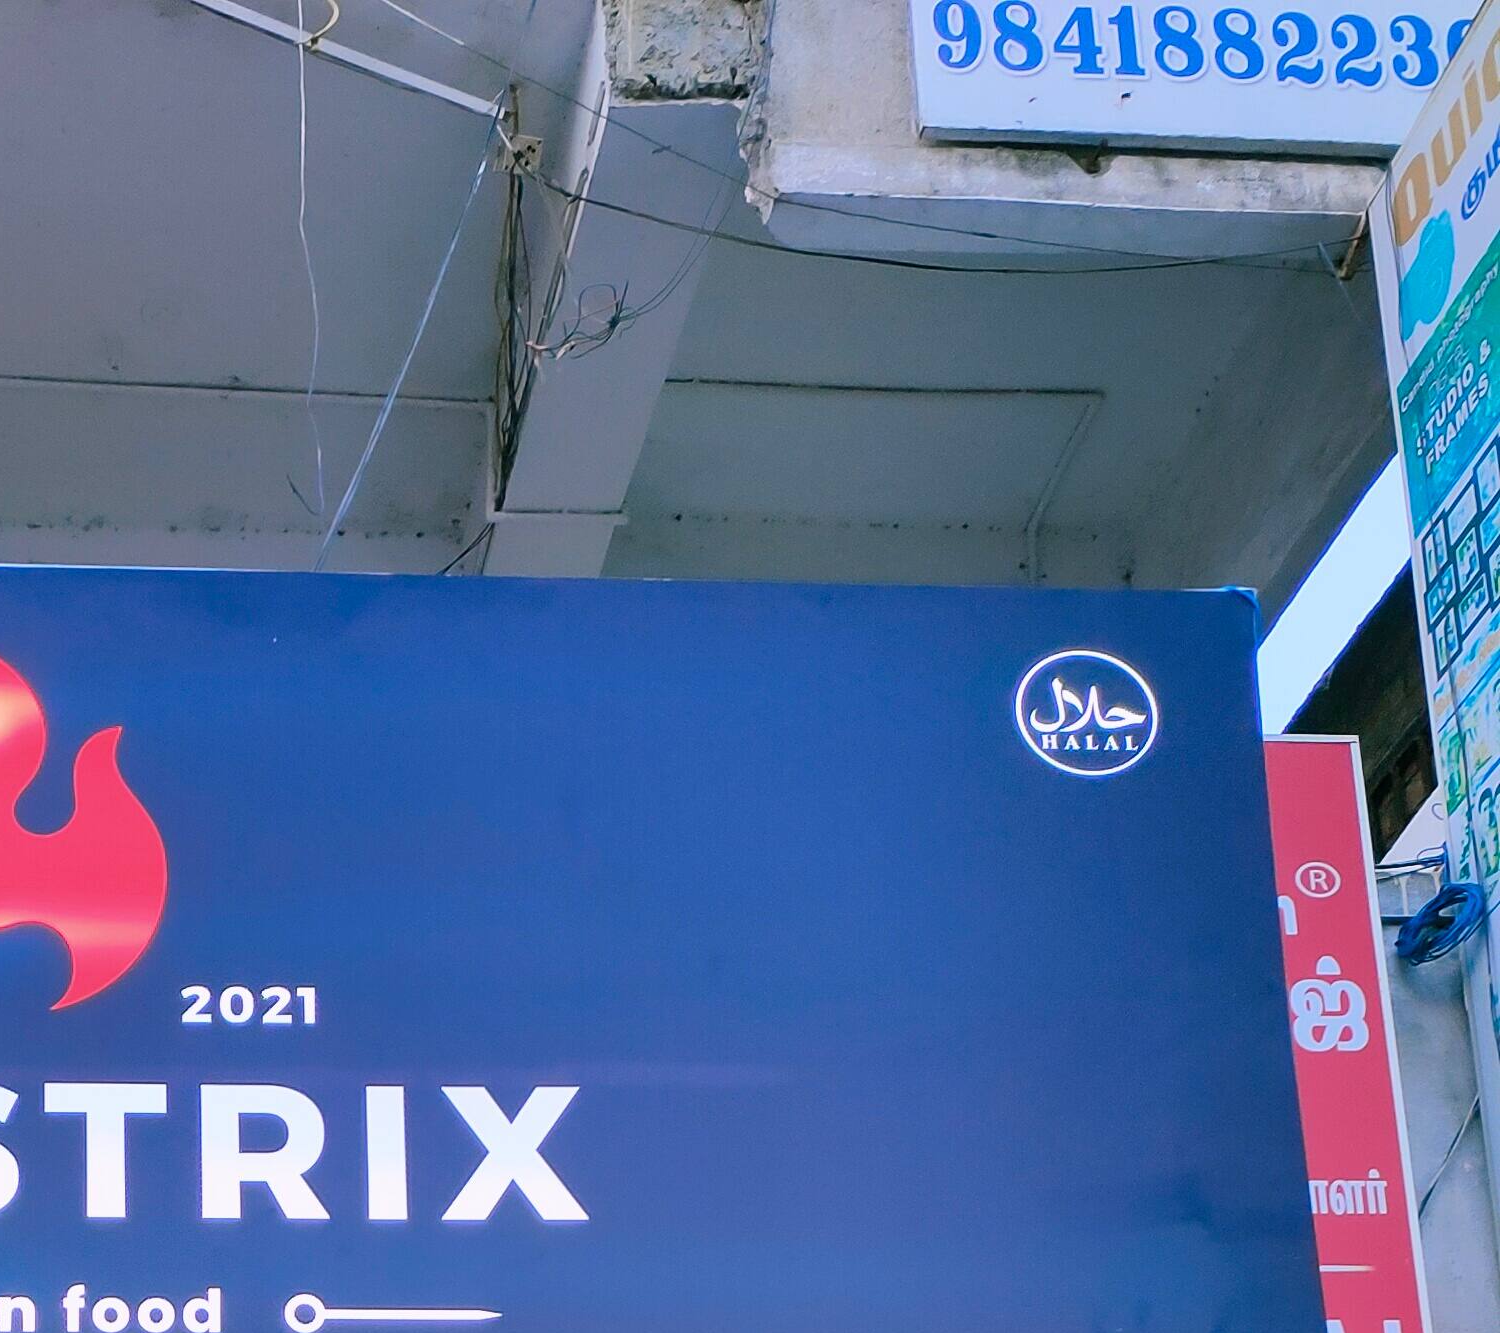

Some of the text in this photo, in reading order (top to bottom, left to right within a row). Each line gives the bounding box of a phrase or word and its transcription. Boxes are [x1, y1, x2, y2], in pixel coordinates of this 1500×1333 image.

[1401, 360, 1436, 413] Candid
[1425, 372, 1490, 476] FRAMES
[1029, 677, 1148, 733] حلال
[1041, 734, 1140, 752] HALAL
[180, 985, 317, 1025] 2021
